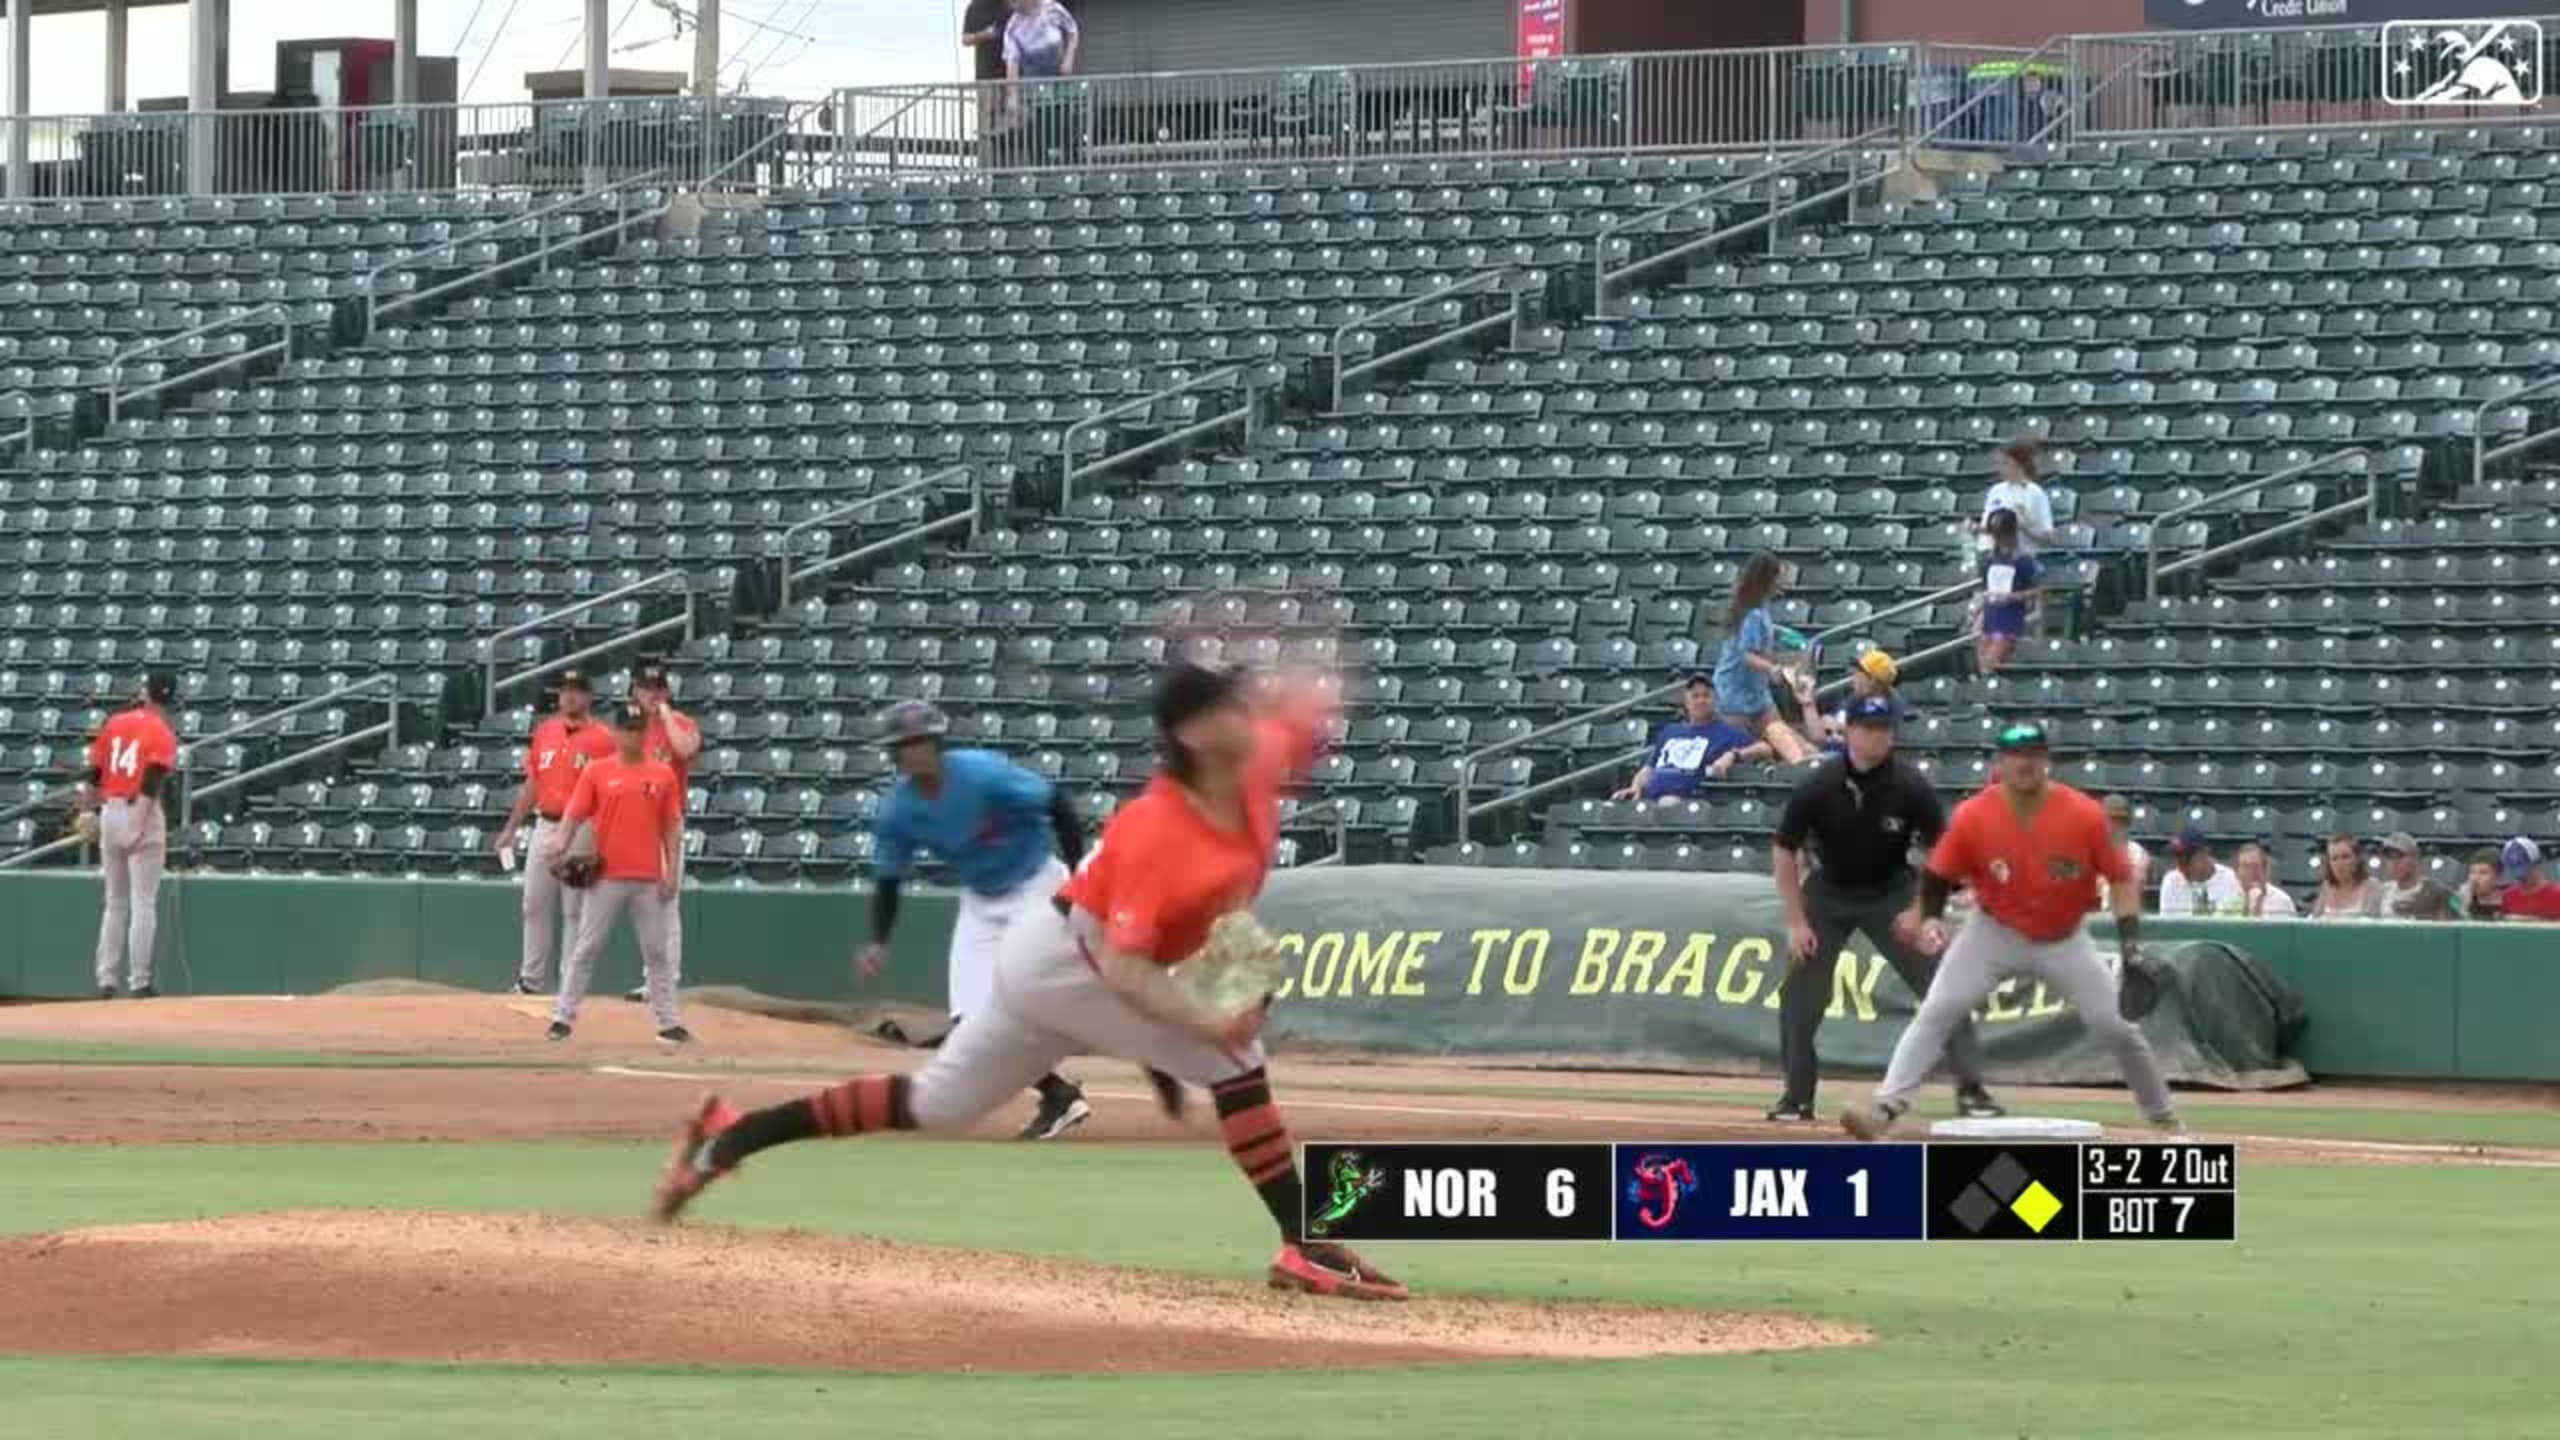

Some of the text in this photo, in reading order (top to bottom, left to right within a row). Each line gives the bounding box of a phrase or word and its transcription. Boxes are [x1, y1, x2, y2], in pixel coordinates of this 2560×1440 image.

[110, 736, 139, 777] 14
[1466, 928, 1551, 995] TO
[1568, 927, 1888, 1022] BRAGN
